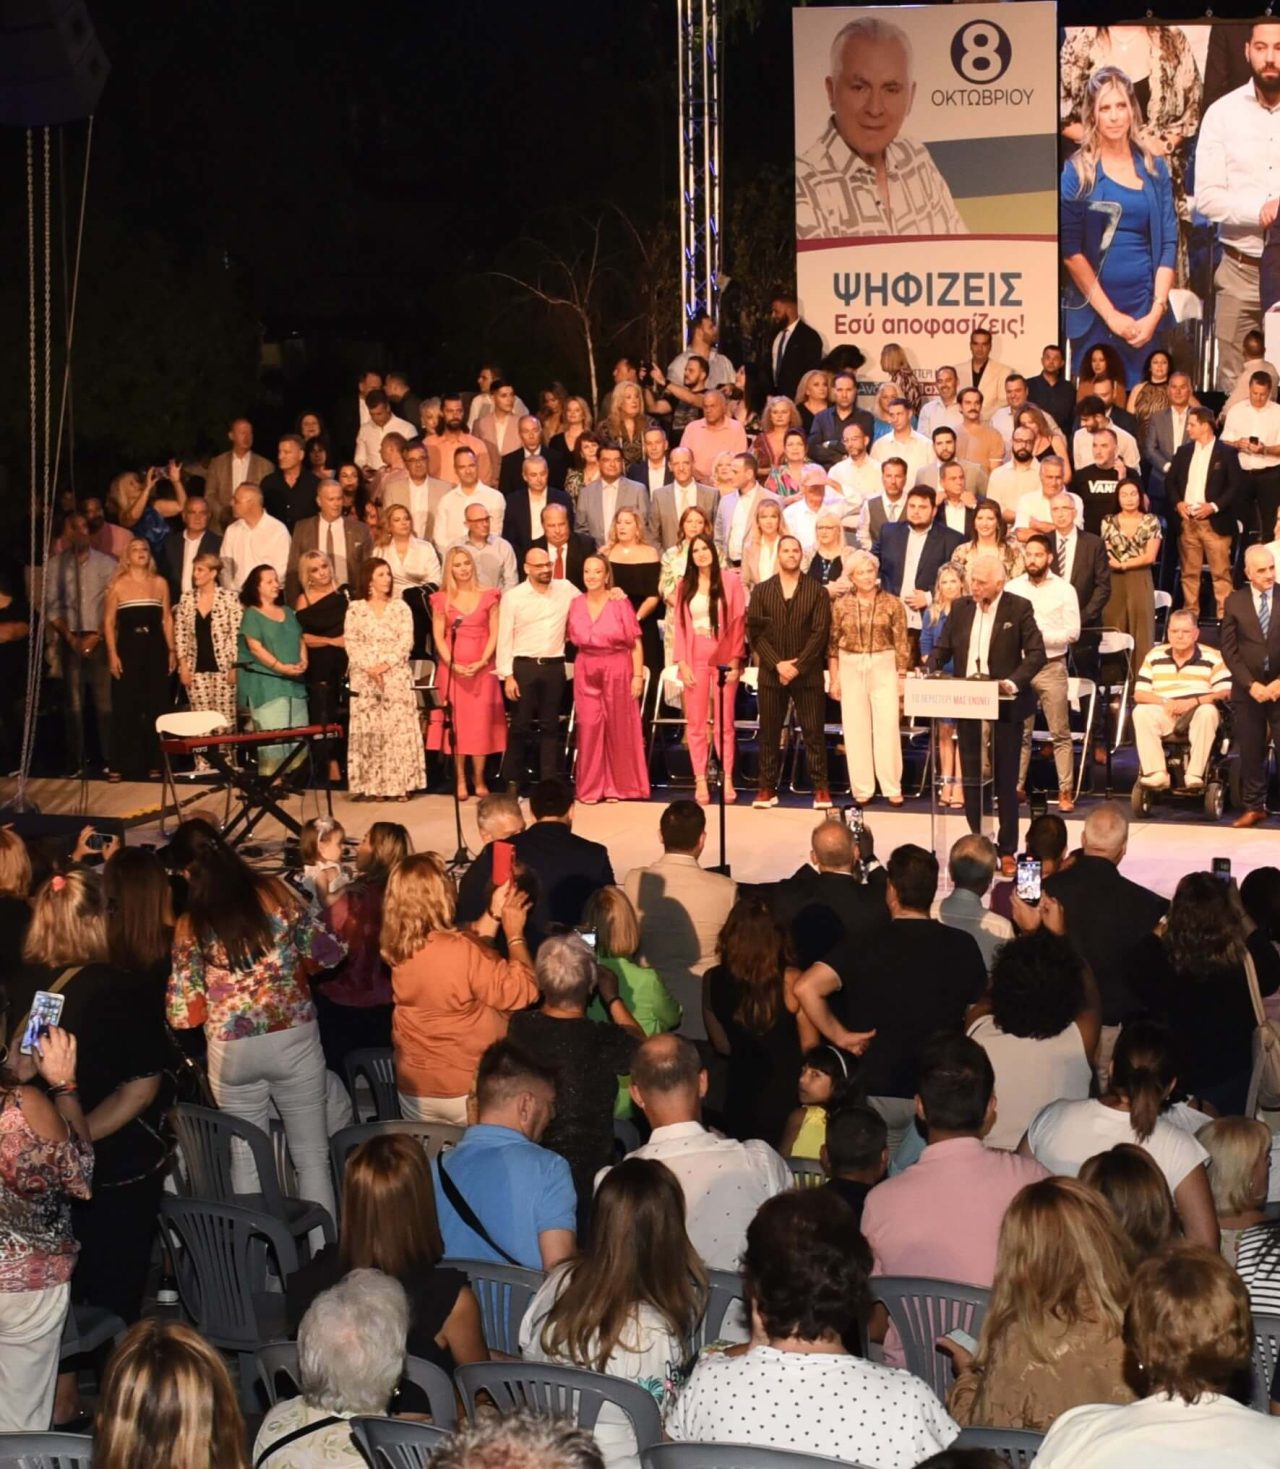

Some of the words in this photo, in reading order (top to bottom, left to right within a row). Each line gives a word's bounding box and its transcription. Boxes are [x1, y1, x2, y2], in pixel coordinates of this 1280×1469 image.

[959, 22, 1002, 82] 8
[931, 88, 1034, 107] ΟΚΤΩΒΡΙΟΥ
[833, 271, 1023, 307] ΨΗΦΙΖΕΙΣ
[835, 312, 875, 334] Εσύ
[882, 312, 1025, 338] αποφασίζεις!
